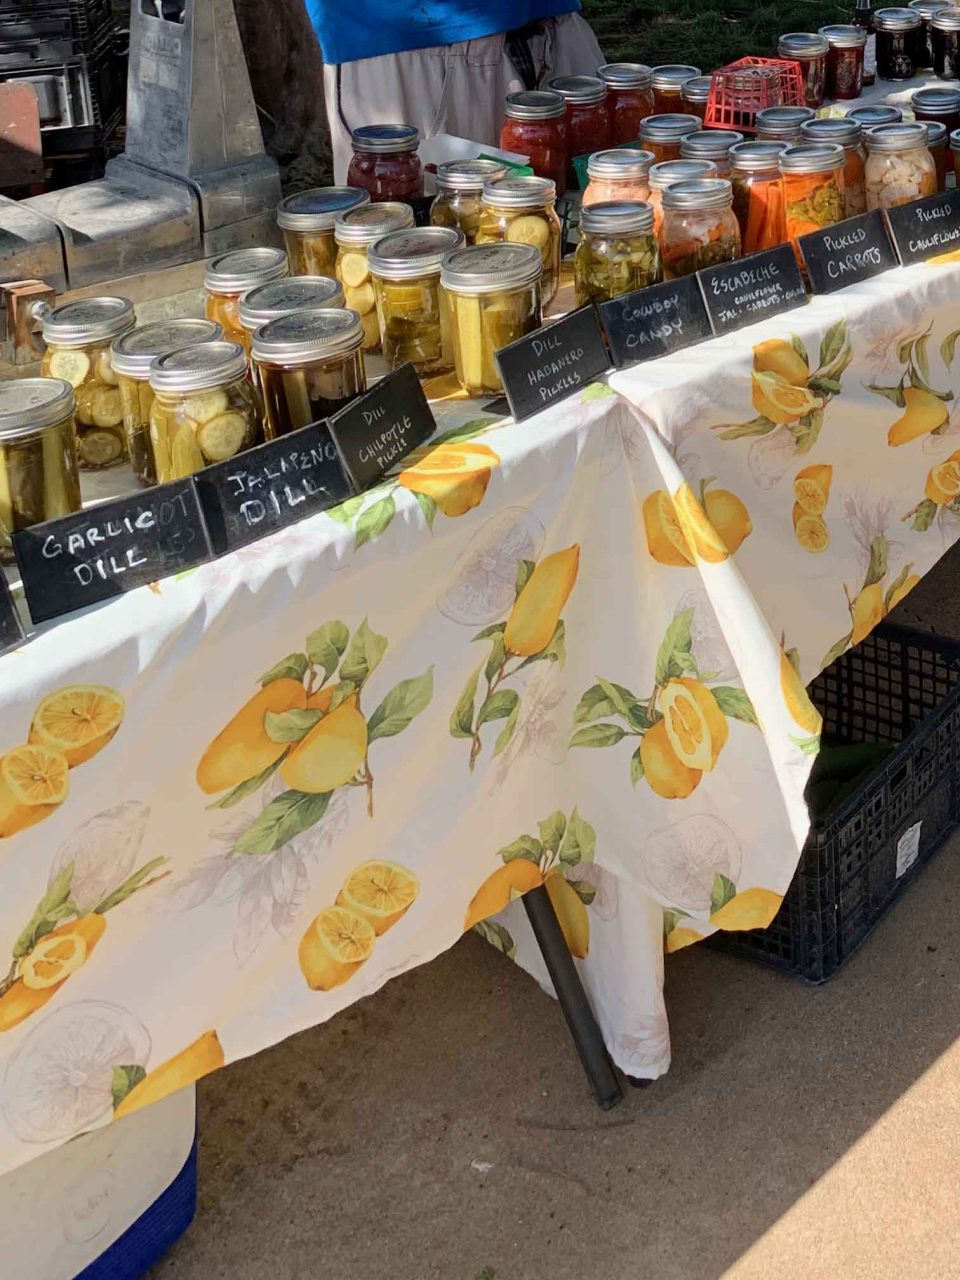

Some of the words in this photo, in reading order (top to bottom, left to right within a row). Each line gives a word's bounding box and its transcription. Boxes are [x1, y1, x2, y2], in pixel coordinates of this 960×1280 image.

[823, 228, 866, 252] PICKLED
[710, 261, 780, 295] ESCABECHE
[827, 247, 882, 279] CARROTS
[622, 293, 679, 322] COWBOY
[531, 332, 563, 358] DILL
[625, 319, 683, 348] CANDY
[527, 347, 585, 386] HABANERO
[539, 371, 582, 401] PICKLES
[362, 405, 387, 426] DILL
[240, 478, 331, 526] DILL
[42, 510, 155, 558] GARLIC
[73, 549, 148, 586] DILL
